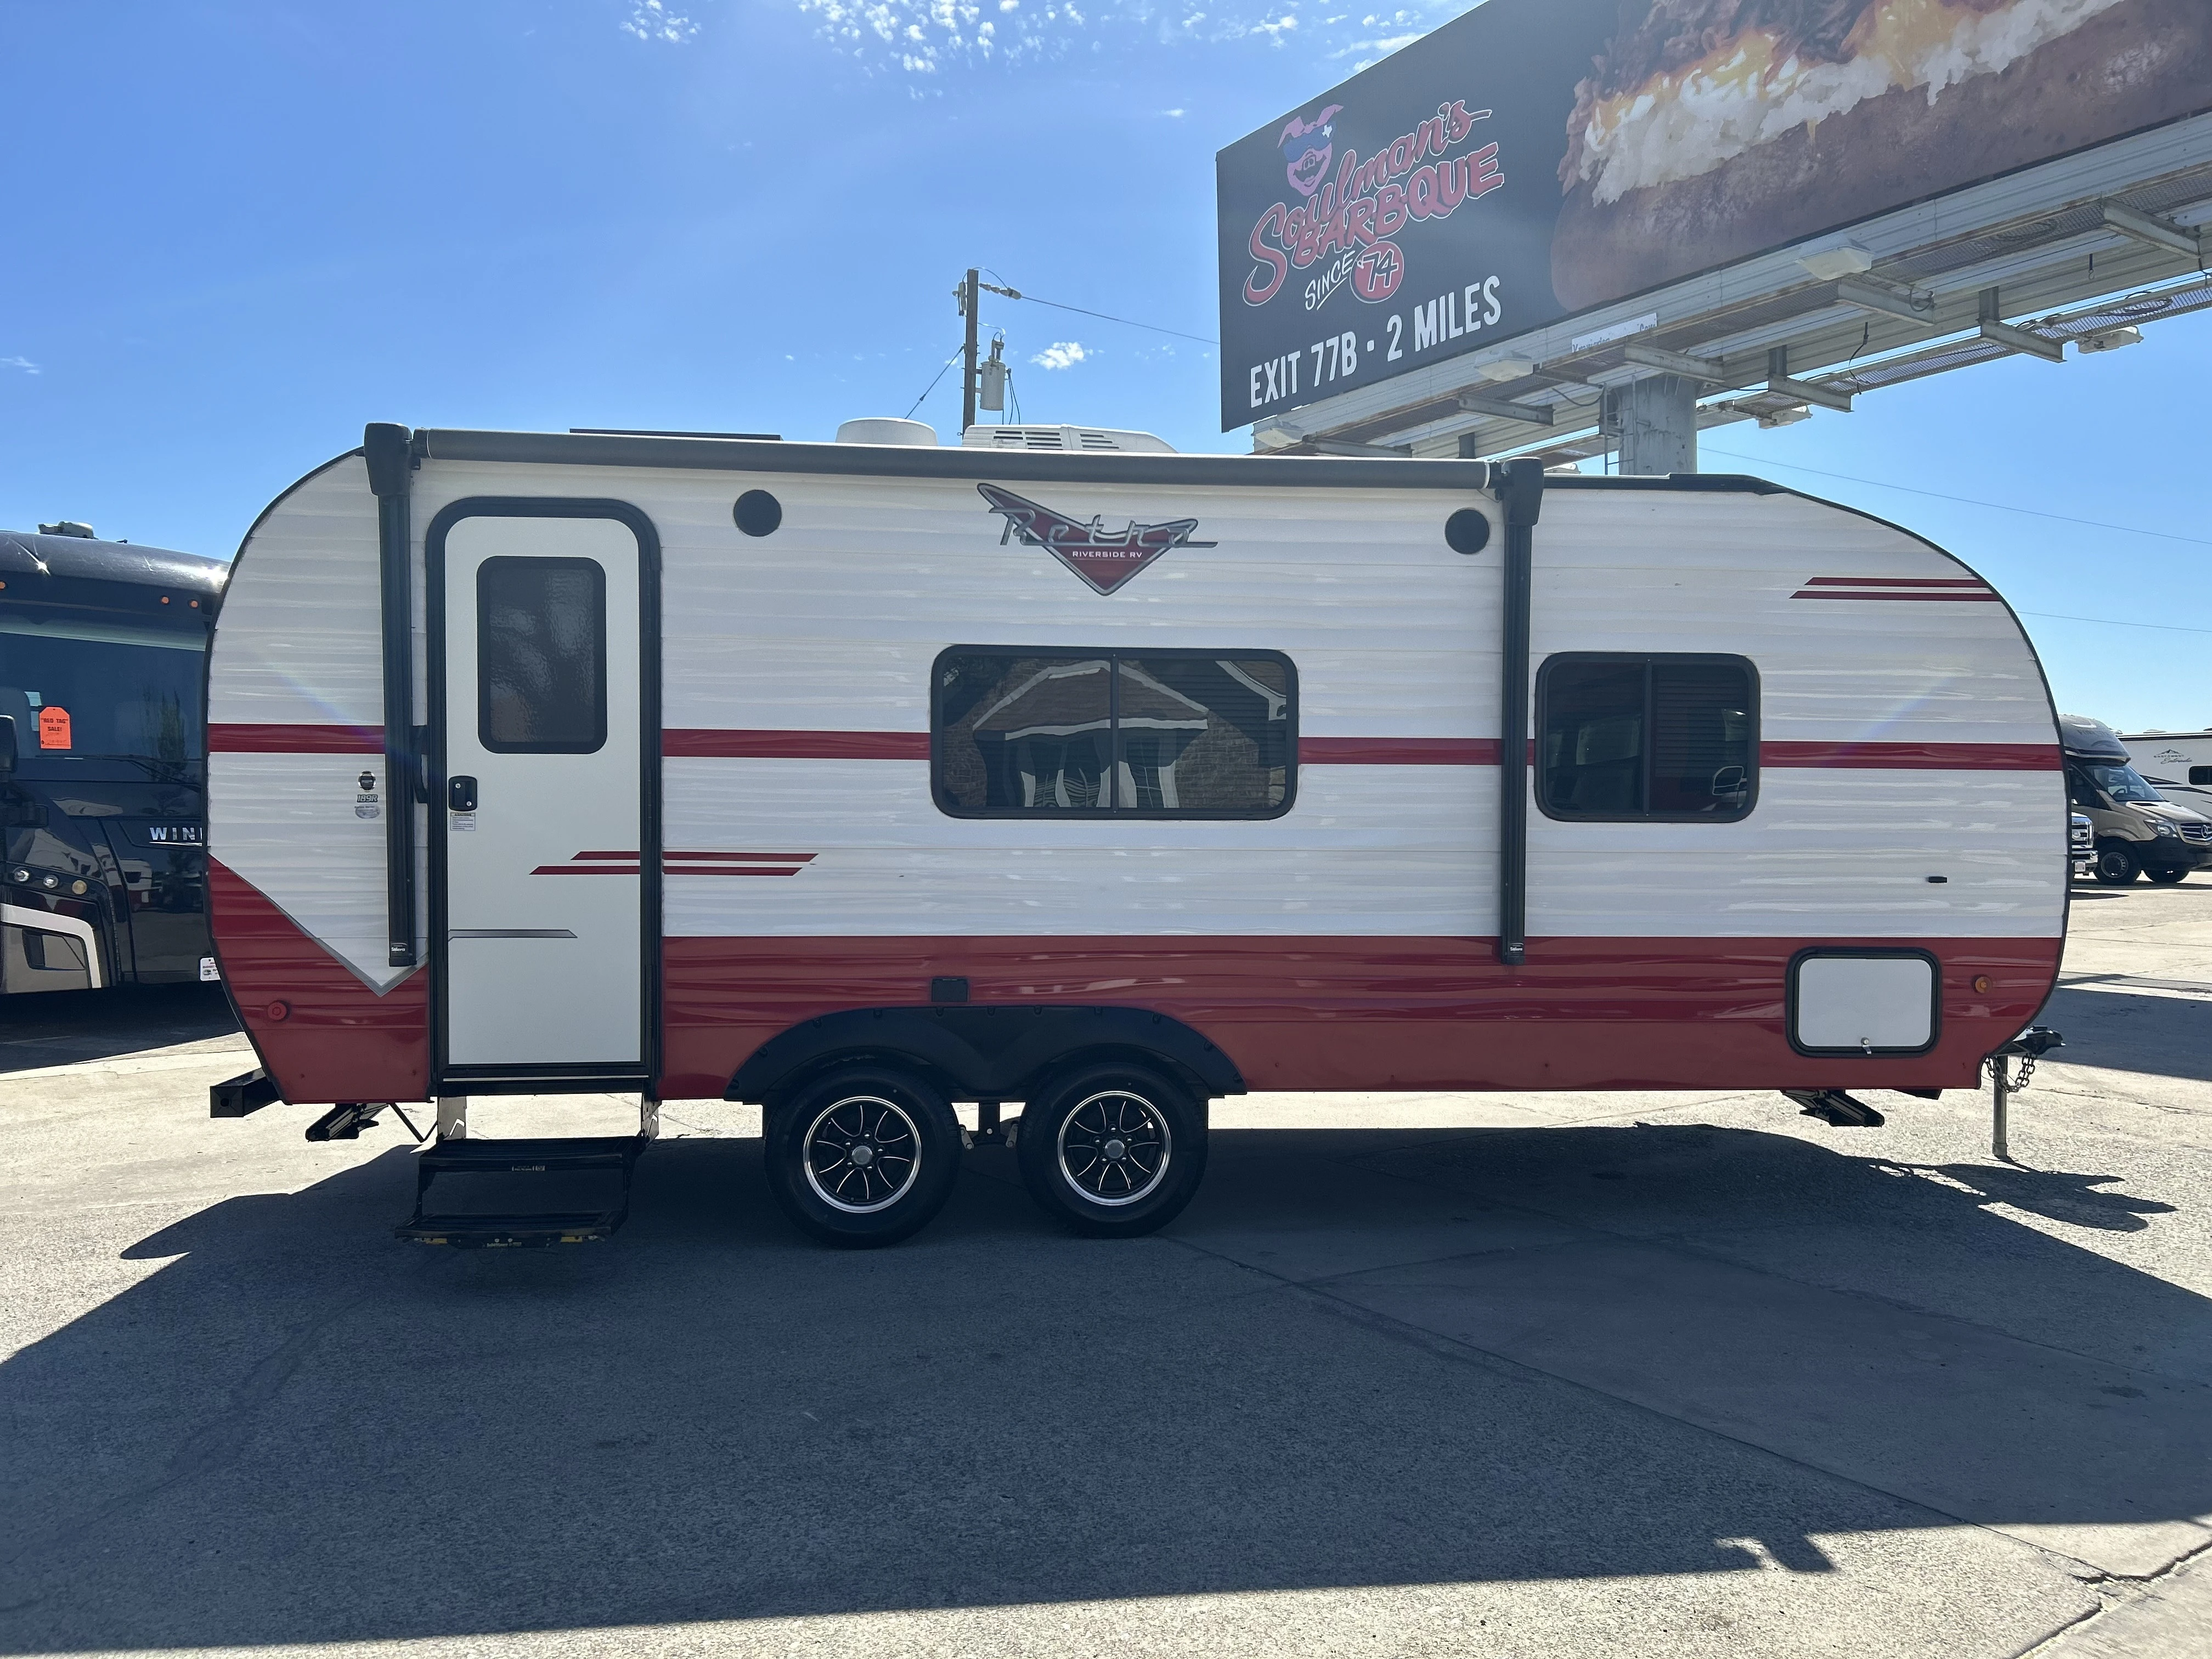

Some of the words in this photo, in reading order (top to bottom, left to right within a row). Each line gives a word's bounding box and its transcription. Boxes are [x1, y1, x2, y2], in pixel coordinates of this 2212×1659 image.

[1243, 99, 1492, 307] Soulman's
[1305, 250, 1357, 311] SINCE
[1250, 351, 1301, 408] EXIT
[1311, 331, 1358, 387] 77B
[1387, 314, 1403, 362] 2
[1414, 275, 1502, 353] MILES
[988, 507, 1218, 548] Retro
[357, 794, 379, 803] 189R
